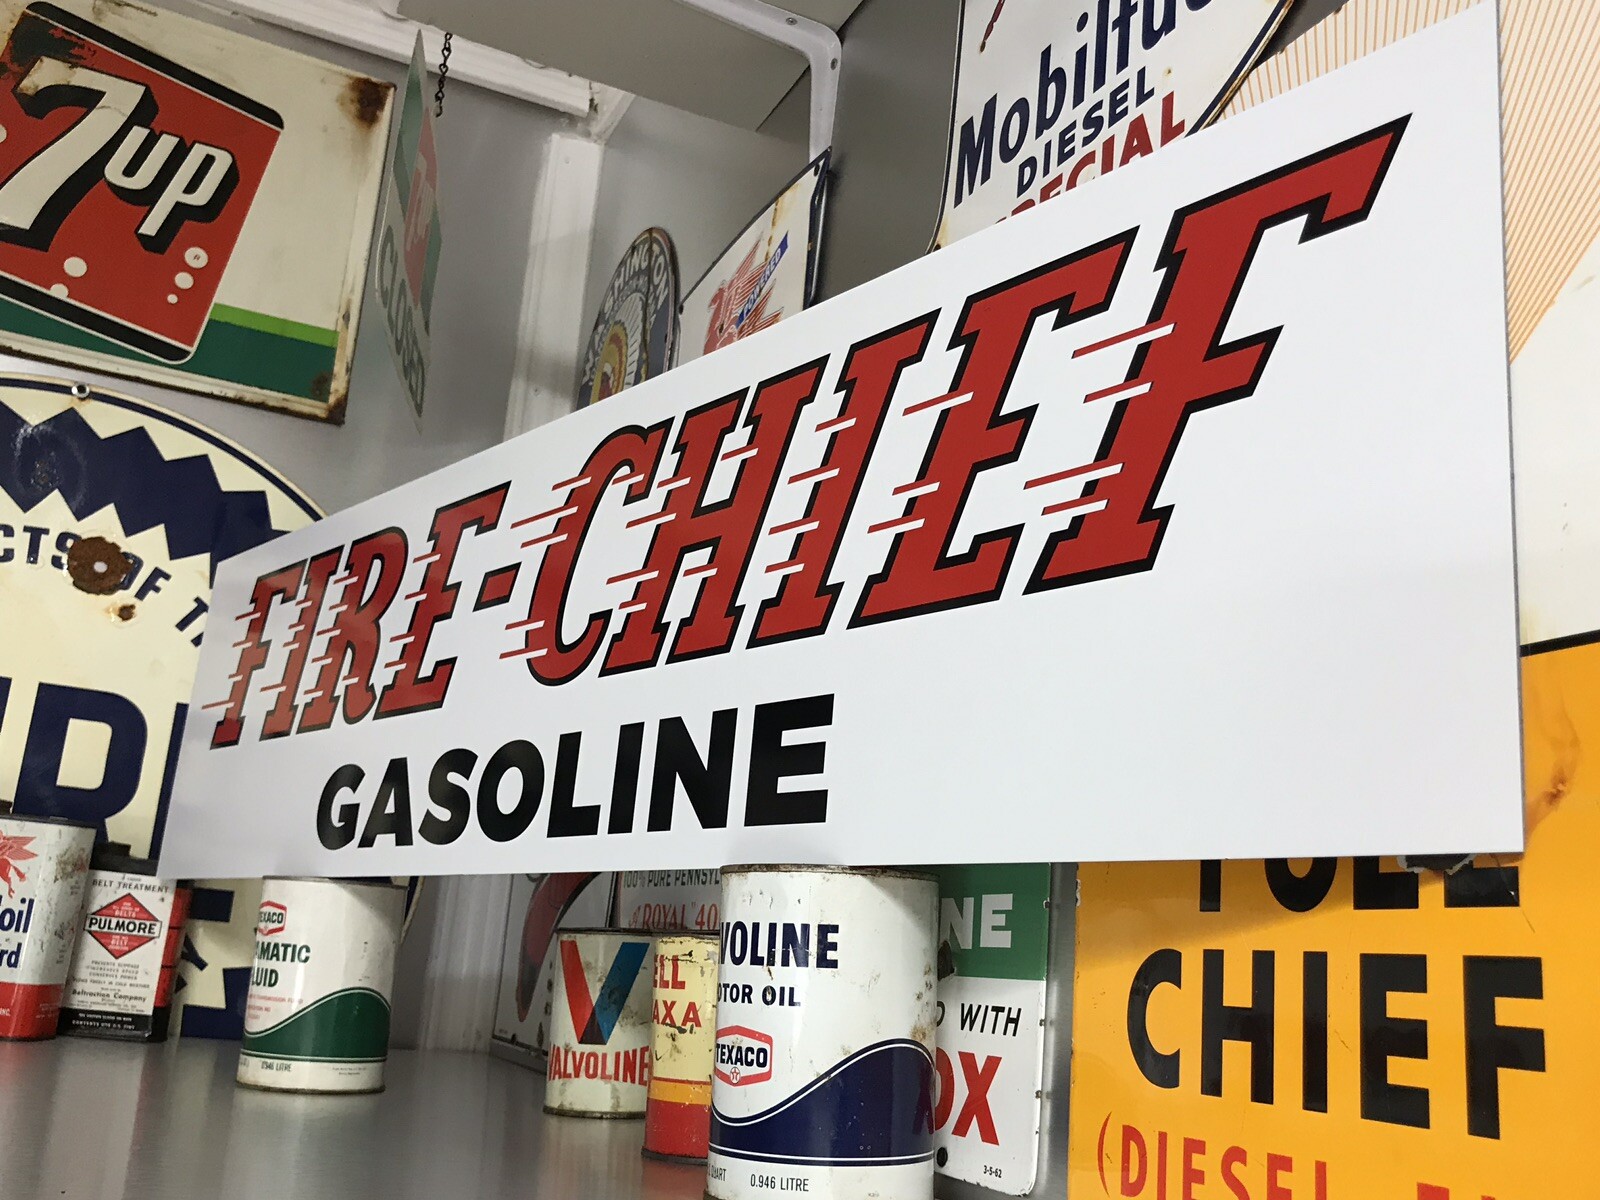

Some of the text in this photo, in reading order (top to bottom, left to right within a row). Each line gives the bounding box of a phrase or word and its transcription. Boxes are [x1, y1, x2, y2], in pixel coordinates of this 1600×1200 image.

[954, 0, 1212, 208] Mobilfu
[1017, 66, 1155, 199] DIESEL
[205, 114, 1412, 749] FIRE-CHIEF
[317, 694, 834, 849] GASOLINE
[92, 879, 169, 893] BELT TREATMENT
[647, 870, 671, 887] PURE
[0, 896, 35, 934] oil
[89, 917, 157, 935] PULMORE
[258, 911, 284, 924] EXACO
[114, 992, 147, 1002] Company
[762, 985, 801, 1007] OIL
[960, 1002, 1022, 1037] WITH
[716, 1043, 768, 1068] TEXACO
[1127, 948, 1546, 1140] CHIEF
[548, 1044, 650, 1087] VALVOLINE
[750, 1173, 776, 1190] 0.946
[780, 1177, 809, 1192] LITRE
[983, 1165, 1002, 1179] 3-5-62
